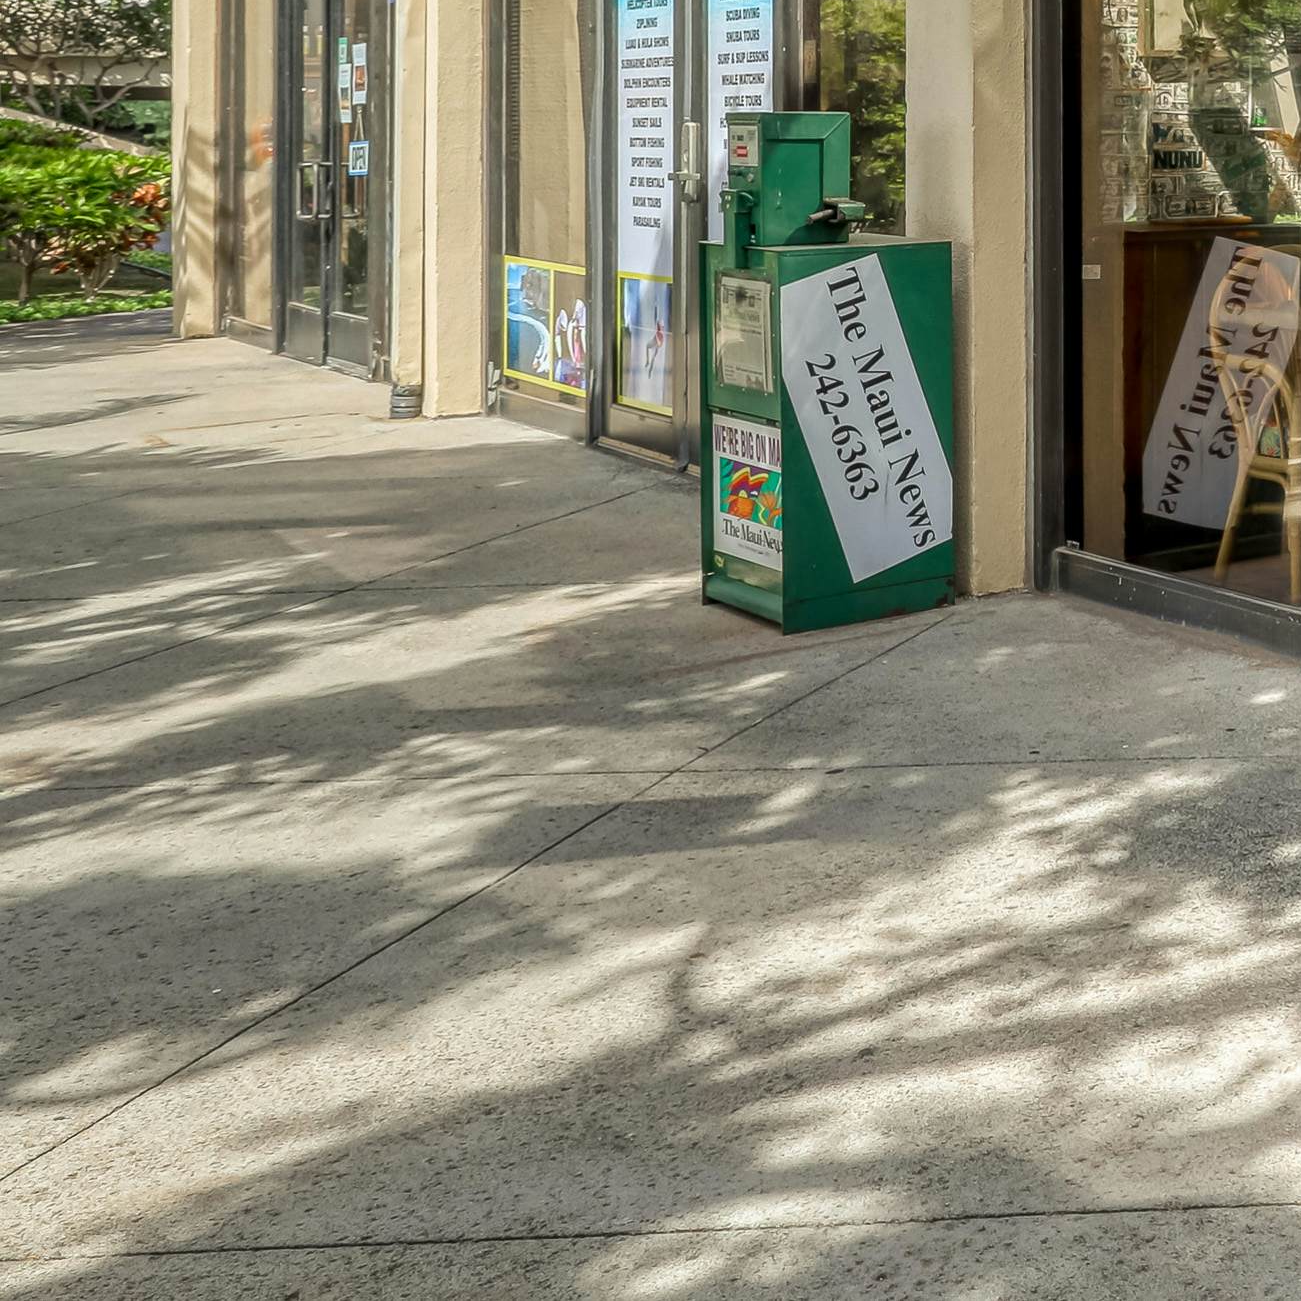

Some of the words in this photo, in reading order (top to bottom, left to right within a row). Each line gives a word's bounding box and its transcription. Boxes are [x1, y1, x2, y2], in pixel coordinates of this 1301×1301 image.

[726, 9, 742, 21] SCUBA
[743, 7, 760, 20] DIVING
[743, 29, 760, 41] TOURS
[717, 53, 731, 65] SURF
[736, 52, 745, 64] SUP
[746, 50, 769, 63] LESSONS
[721, 73, 738, 86] WHALE
[739, 72, 765, 85] WATCHING
[724, 95, 744, 107] BICYCLE
[745, 94, 762, 107] TOURS
[825, 266, 867, 343] The
[851, 343, 912, 449] Maui
[888, 447, 936, 549] News
[805, 353, 880, 501] 242-6363
[714, 423, 739, 456] WE'RE
[740, 429, 754, 460] BIG
[755, 433, 767, 465] ON
[722, 518, 740, 539] The
[741, 523, 763, 547] Maui
